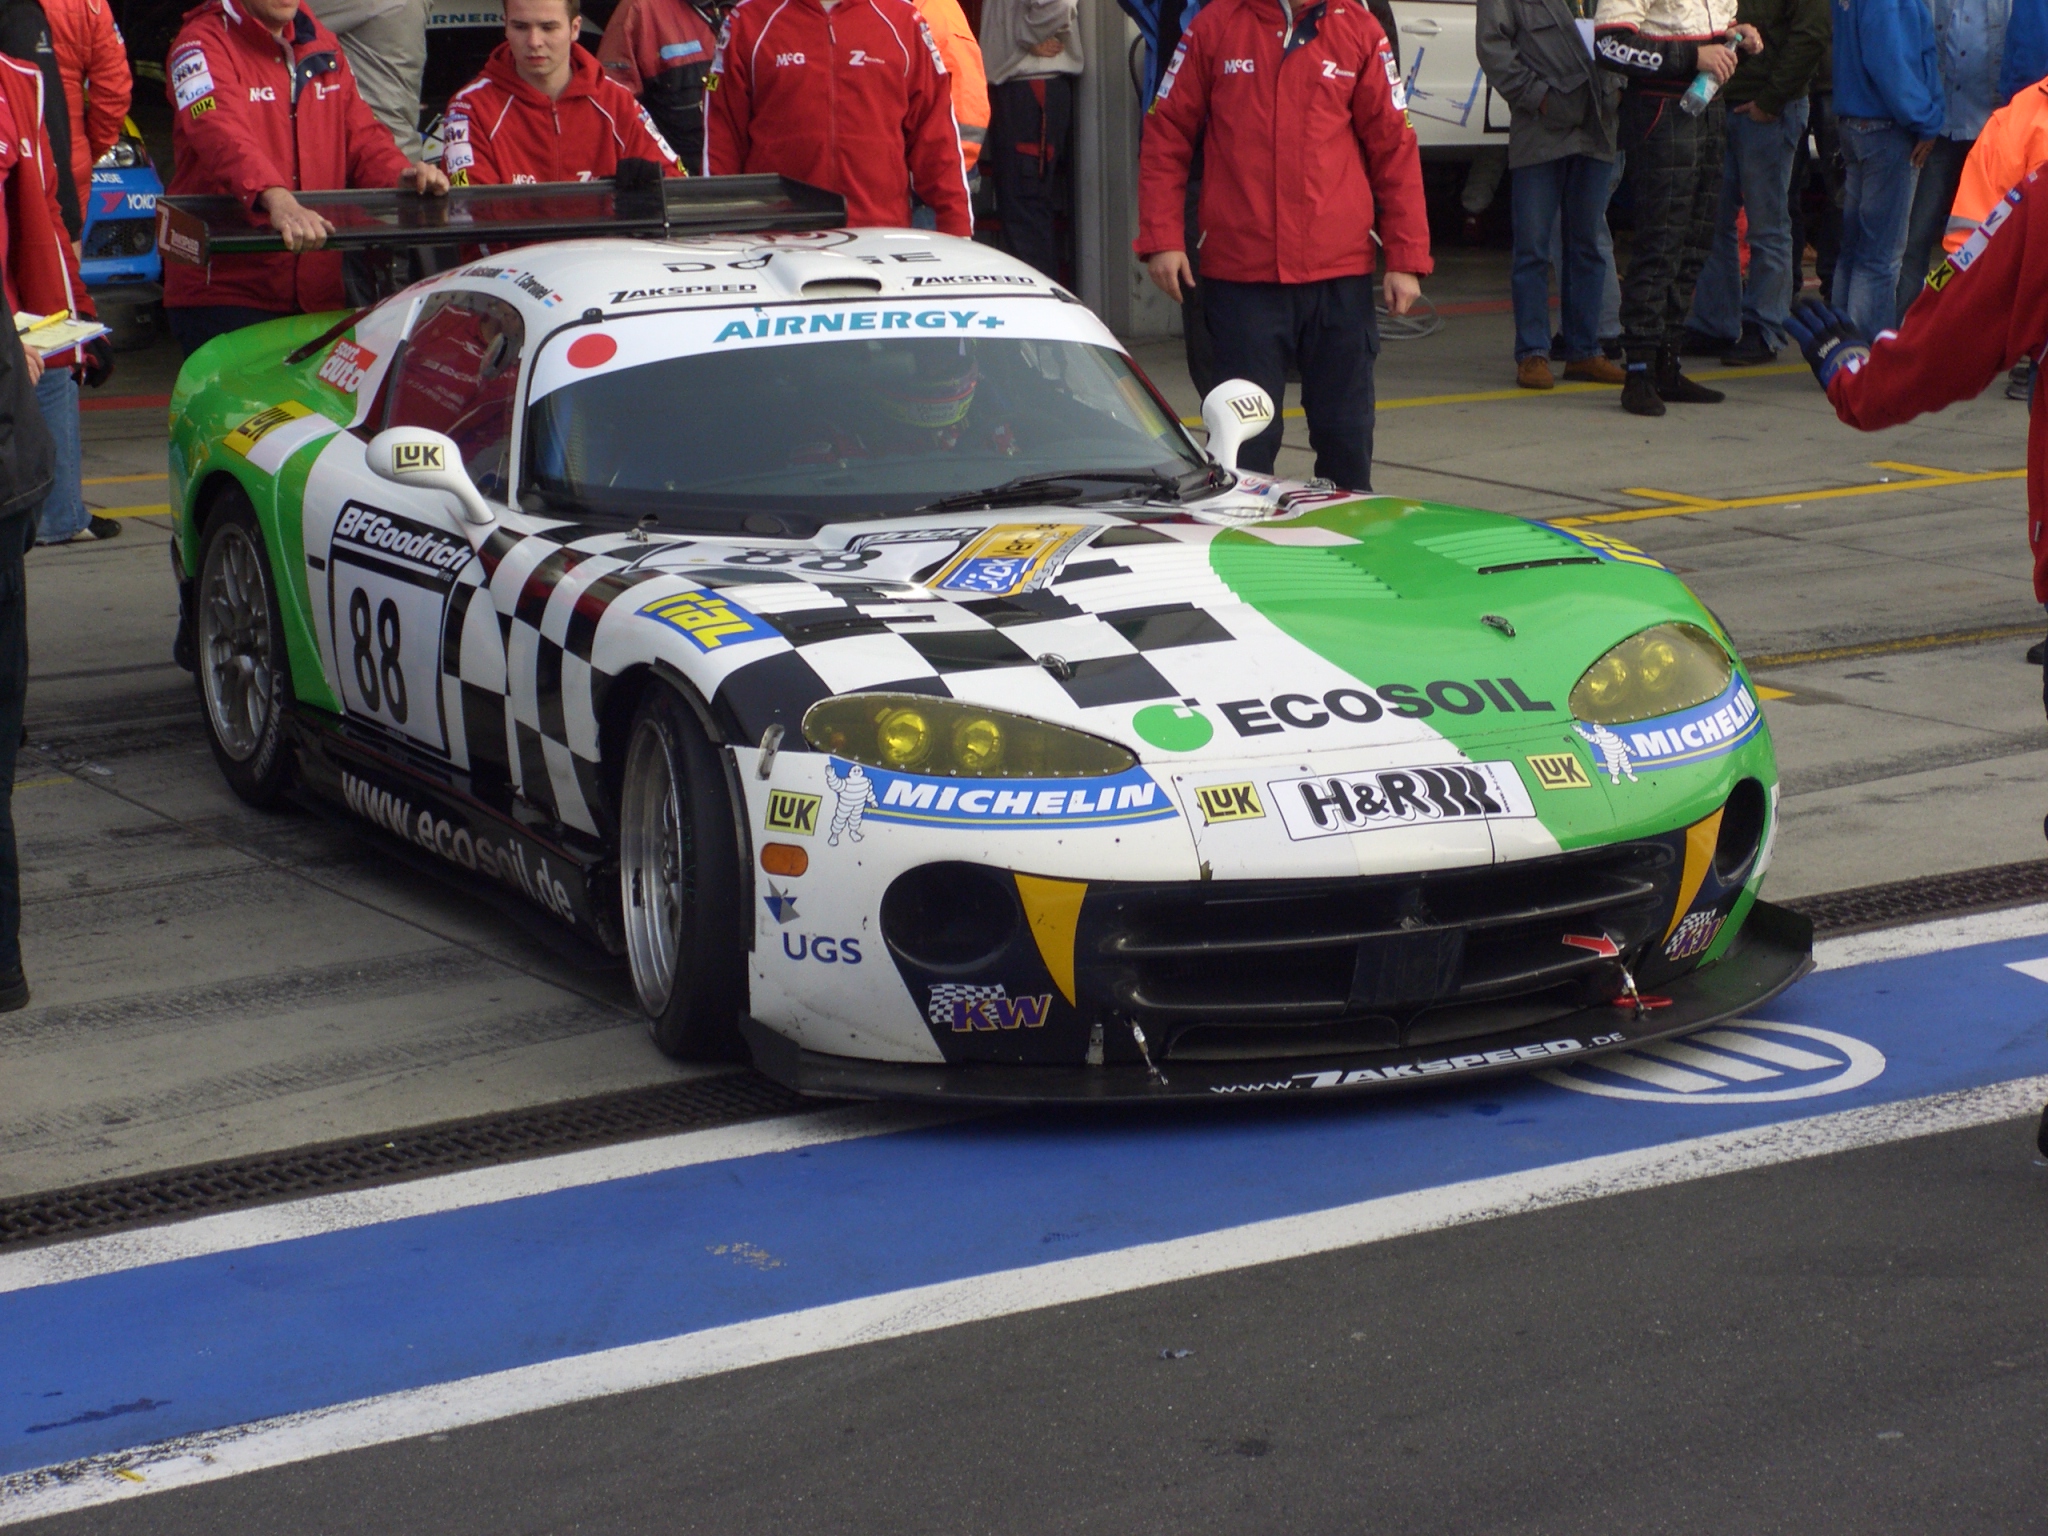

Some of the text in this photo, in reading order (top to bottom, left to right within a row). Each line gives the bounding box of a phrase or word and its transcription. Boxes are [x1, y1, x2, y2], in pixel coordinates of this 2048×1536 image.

[185, 84, 212, 102] UGS
[608, 283, 757, 305] ZAKSPEED
[906, 274, 1036, 288] ZAKSPEED
[395, 446, 440, 468] LUK
[336, 507, 471, 571] BFGoodrich
[349, 587, 408, 725] 88
[1216, 678, 1557, 737] ECOSOIL
[1631, 684, 1756, 758] MICHELIN
[1533, 756, 1586, 785] LUK
[770, 792, 813, 831] LUK
[882, 779, 1157, 815] MICHELIN
[1200, 786, 1260, 818] LUK
[342, 771, 575, 924] www.ecosoil.de
[783, 932, 863, 964] UGS
[952, 995, 1053, 1032] KW
